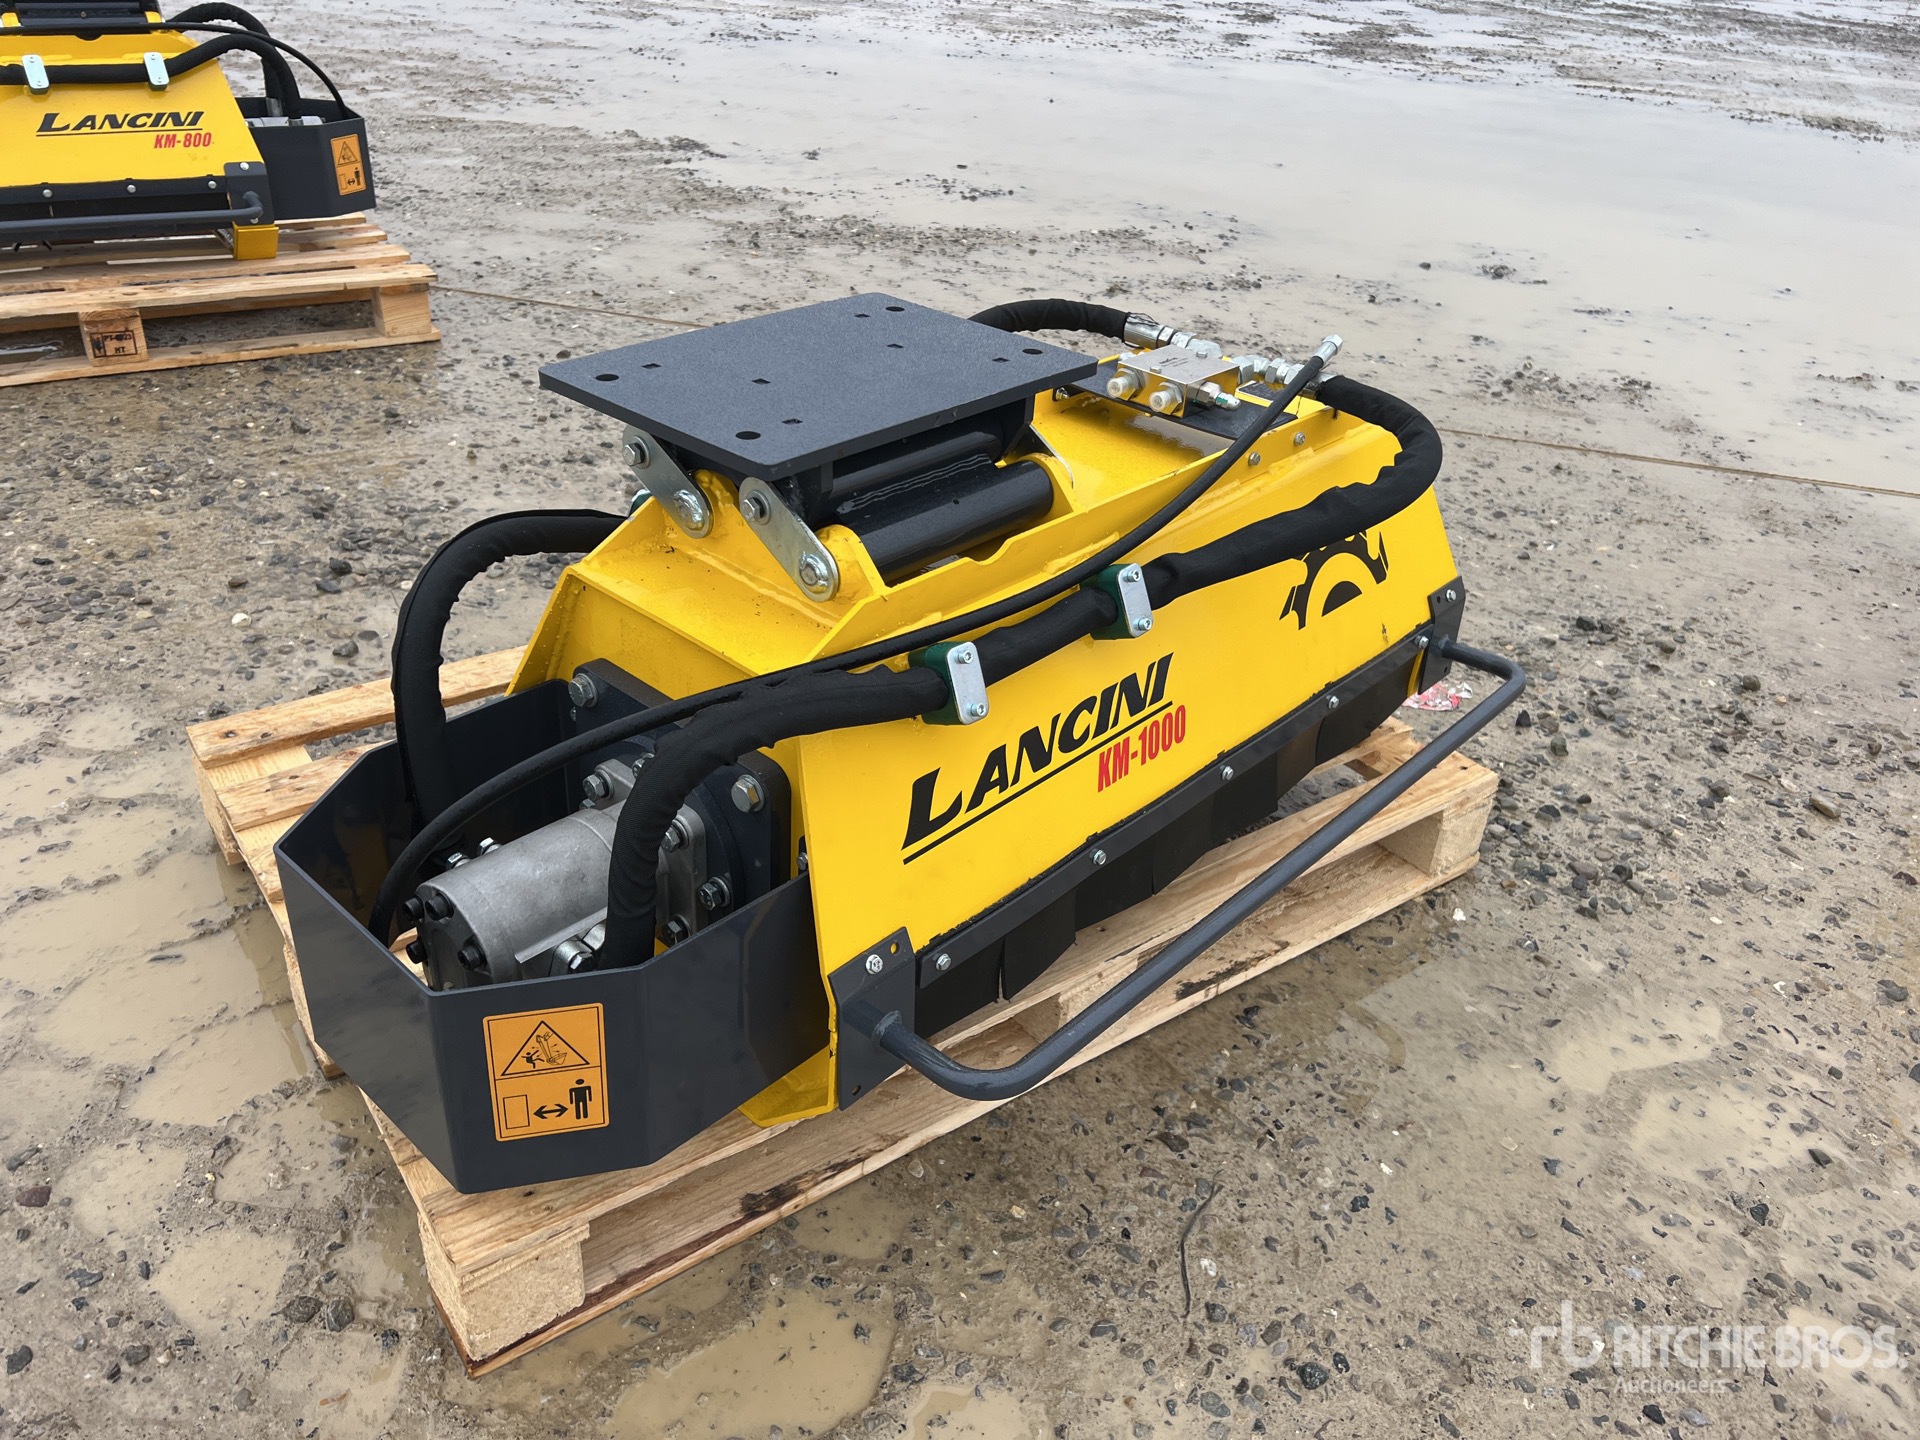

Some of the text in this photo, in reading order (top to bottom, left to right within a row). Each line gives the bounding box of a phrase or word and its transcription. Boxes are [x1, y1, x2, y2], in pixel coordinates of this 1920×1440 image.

[36, 111, 204, 133] LANCINI
[153, 132, 212, 149] KM-800
[901, 652, 1174, 851] LANCINI
[1097, 704, 1187, 793] KM-1000
